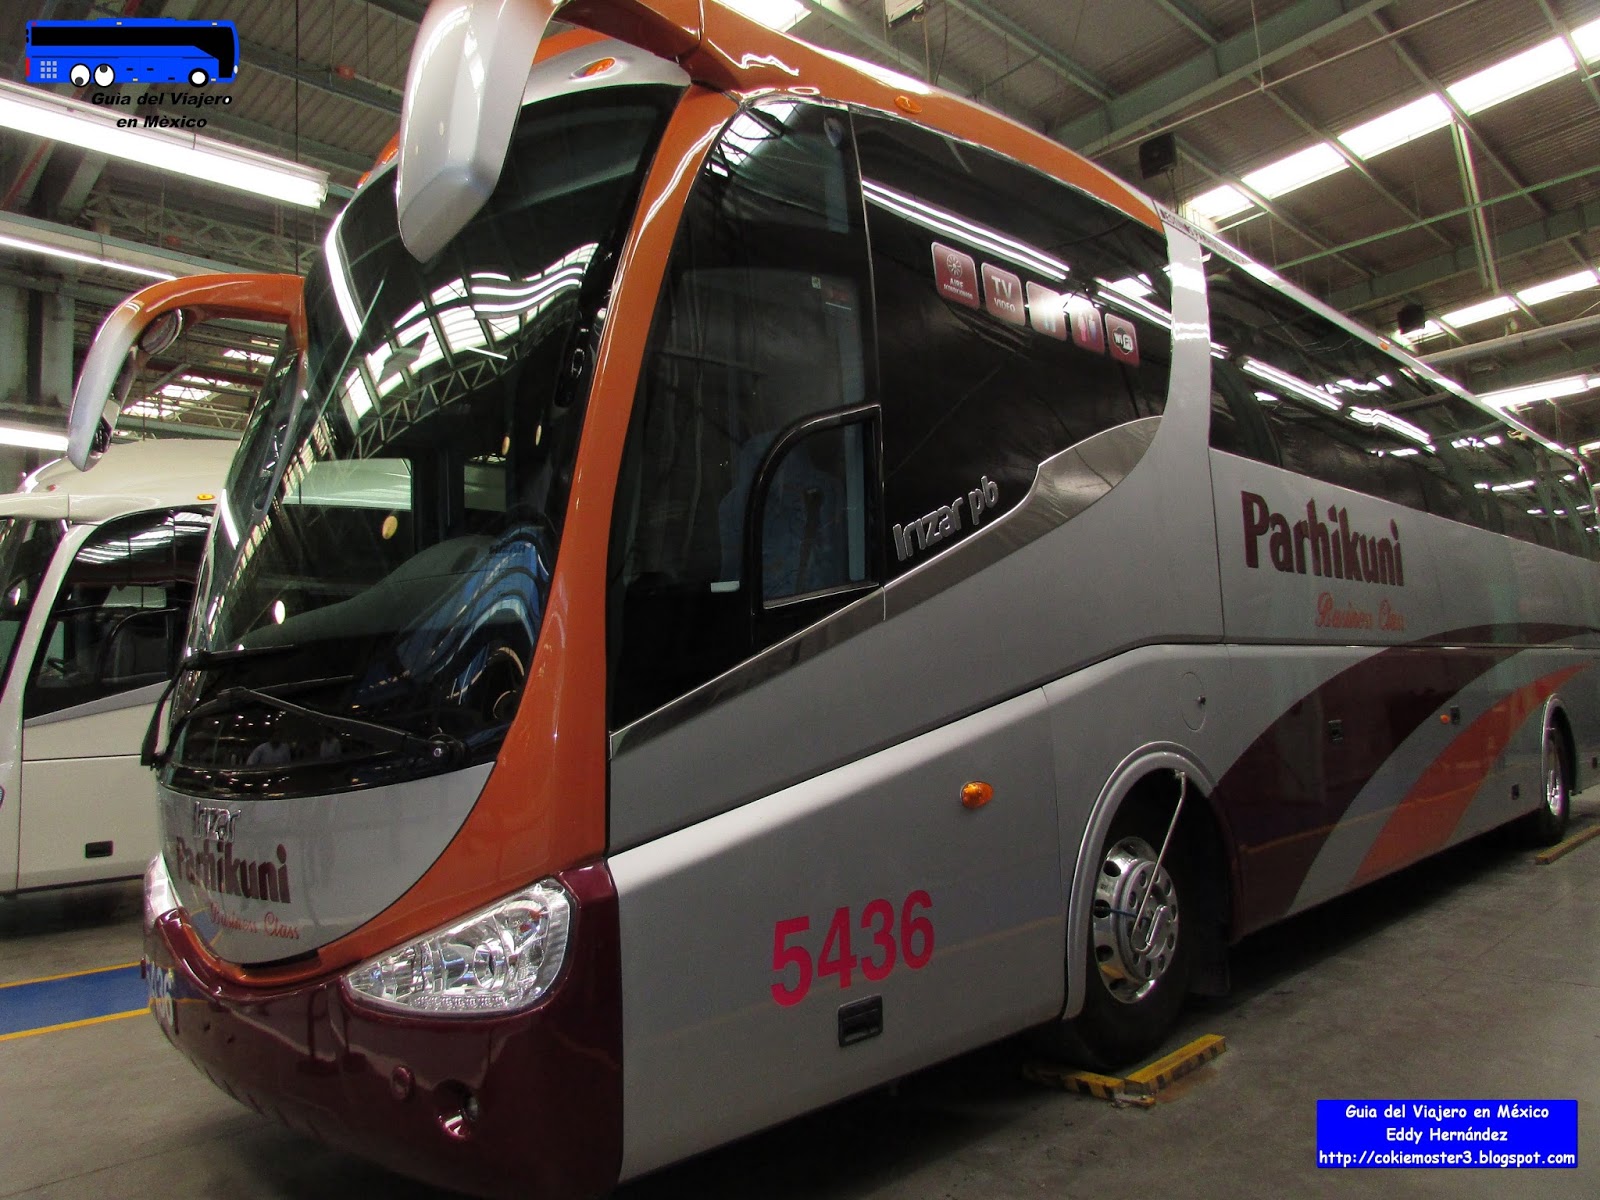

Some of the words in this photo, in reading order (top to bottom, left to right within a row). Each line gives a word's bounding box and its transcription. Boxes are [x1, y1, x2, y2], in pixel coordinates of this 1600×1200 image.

[991, 275, 1012, 299] TV
[994, 298, 1016, 312] VIDEO
[893, 497, 963, 561] Irizar
[968, 475, 999, 525] pb
[1241, 490, 1404, 587] Parhikuni
[176, 836, 291, 903] Parhikuni
[264, 911, 300, 939] Class
[770, 889, 935, 1008] 5436
